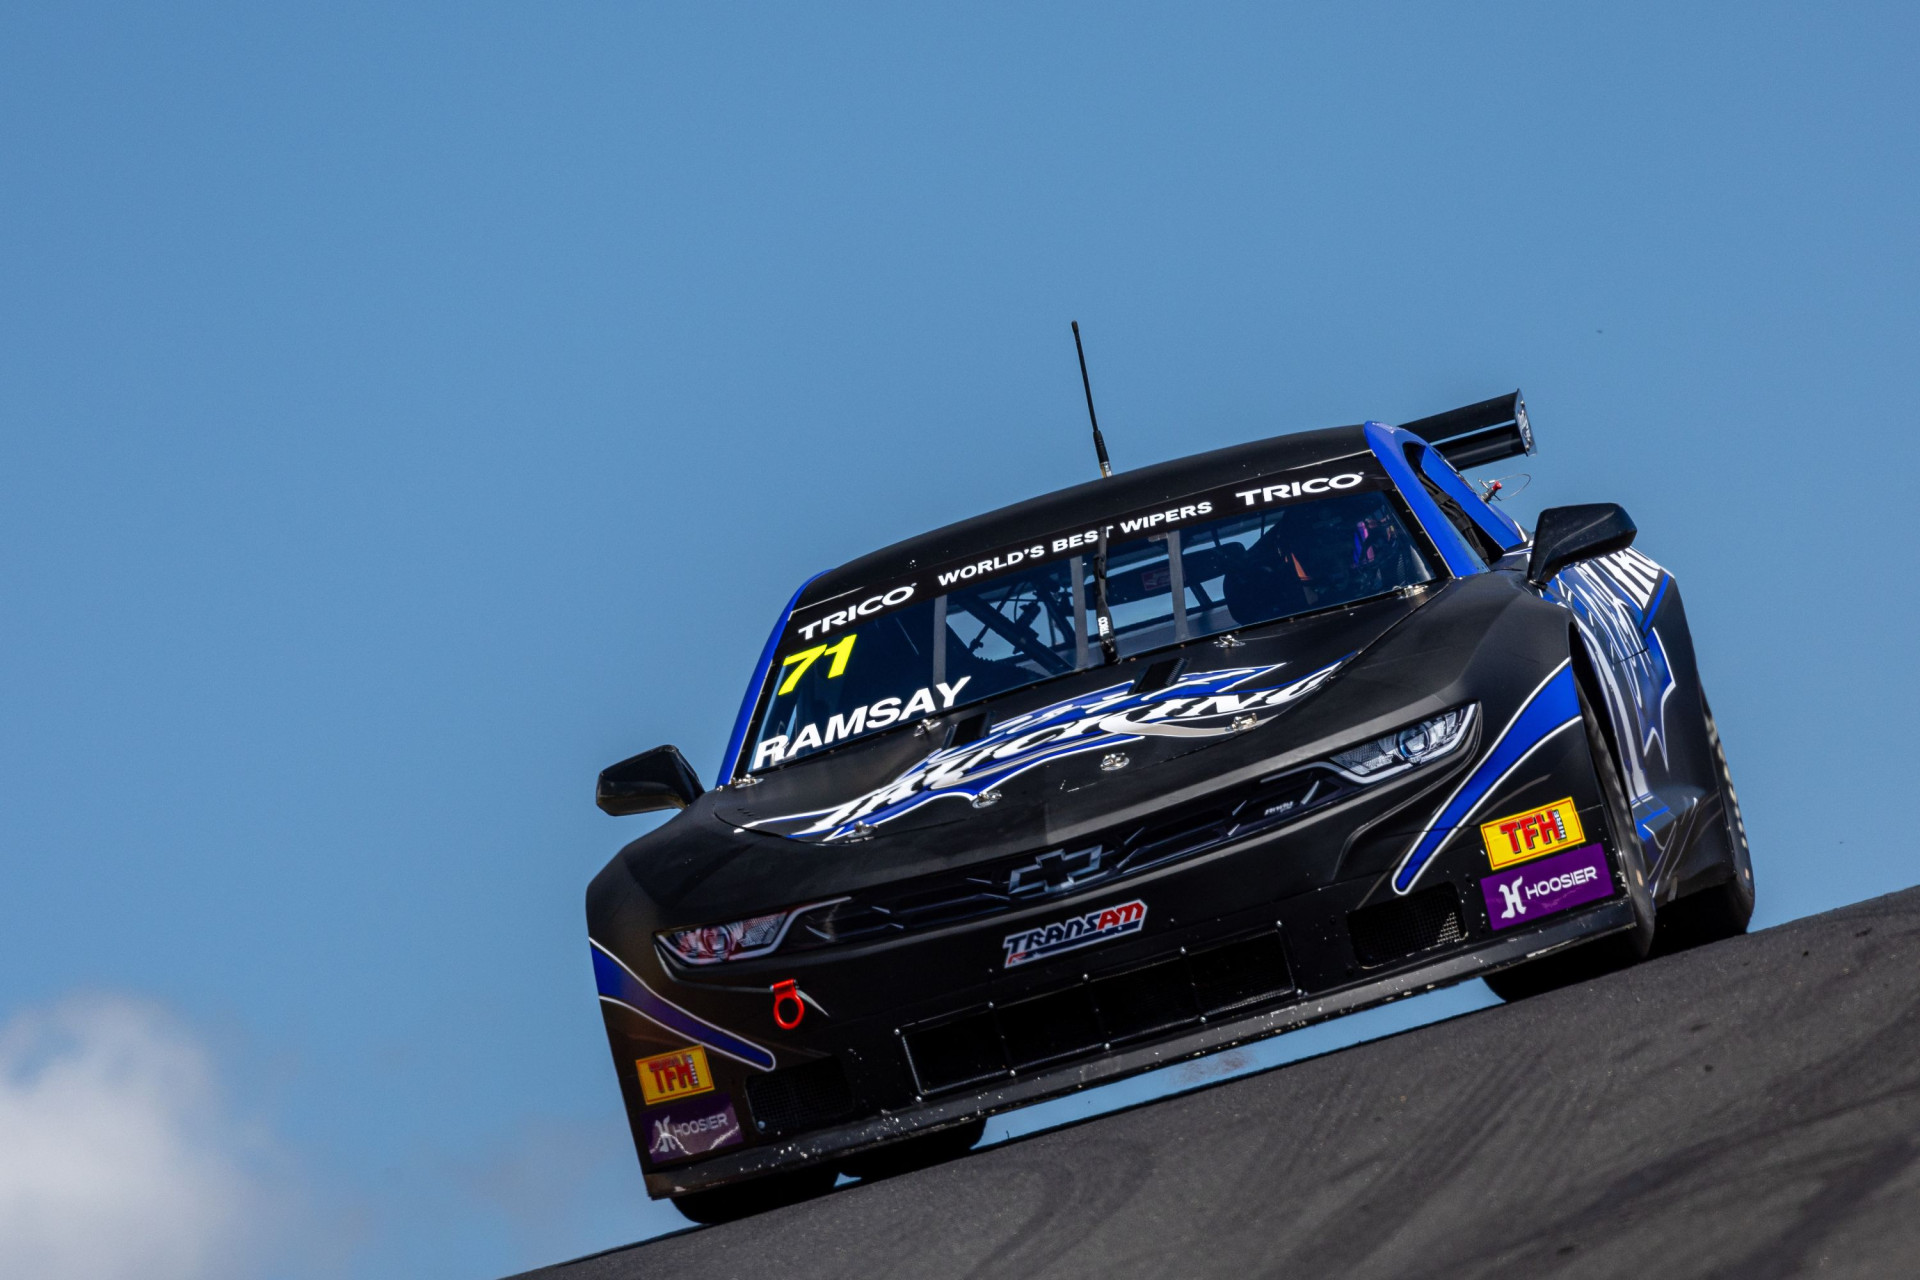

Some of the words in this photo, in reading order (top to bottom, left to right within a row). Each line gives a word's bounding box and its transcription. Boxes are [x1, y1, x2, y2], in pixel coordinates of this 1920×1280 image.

[1235, 473, 1363, 506] TRICO
[938, 545, 1045, 587] WORLD'S
[1120, 501, 1213, 534] WIPERS
[798, 585, 915, 640] TRICO
[778, 634, 857, 695] 71
[752, 675, 971, 769] RAMSAY
[1499, 809, 1562, 854] TFH
[1525, 866, 1598, 900] HOOSIER
[648, 1054, 695, 1093] TFH
